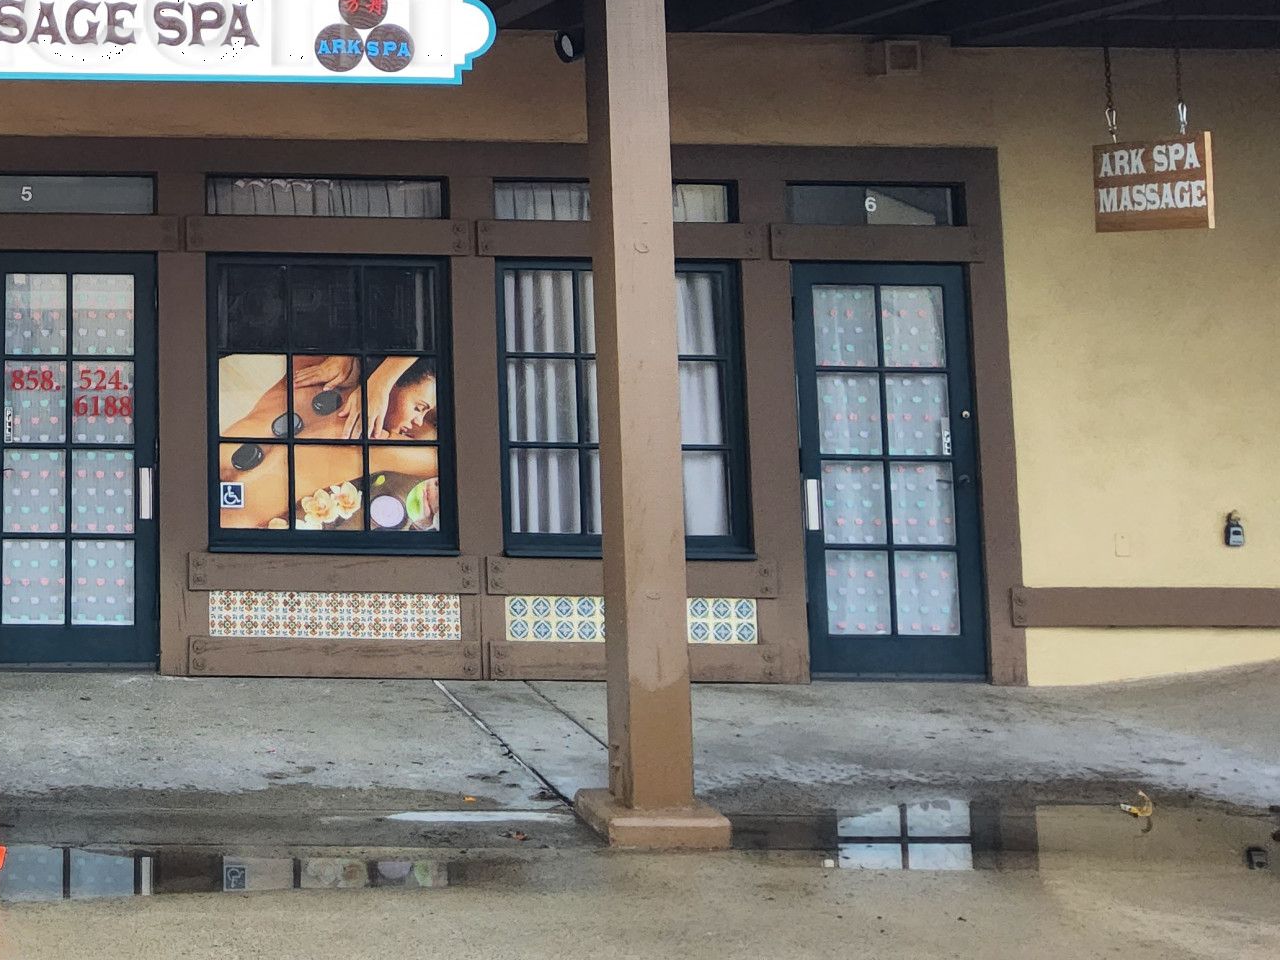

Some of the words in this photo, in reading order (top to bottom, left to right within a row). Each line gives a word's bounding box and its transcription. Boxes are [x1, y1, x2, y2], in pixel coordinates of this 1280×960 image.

[152, 0, 260, 47] SPA
[318, 38, 361, 55] ARK
[366, 40, 411, 58] SPA
[1099, 148, 1146, 178] ARK
[1152, 142, 1201, 172] SPA
[21, 186, 32, 201] 5
[865, 196, 876, 212] 6
[1099, 180, 1207, 213] MASSAGE
[74, 395, 132, 417] 6188
